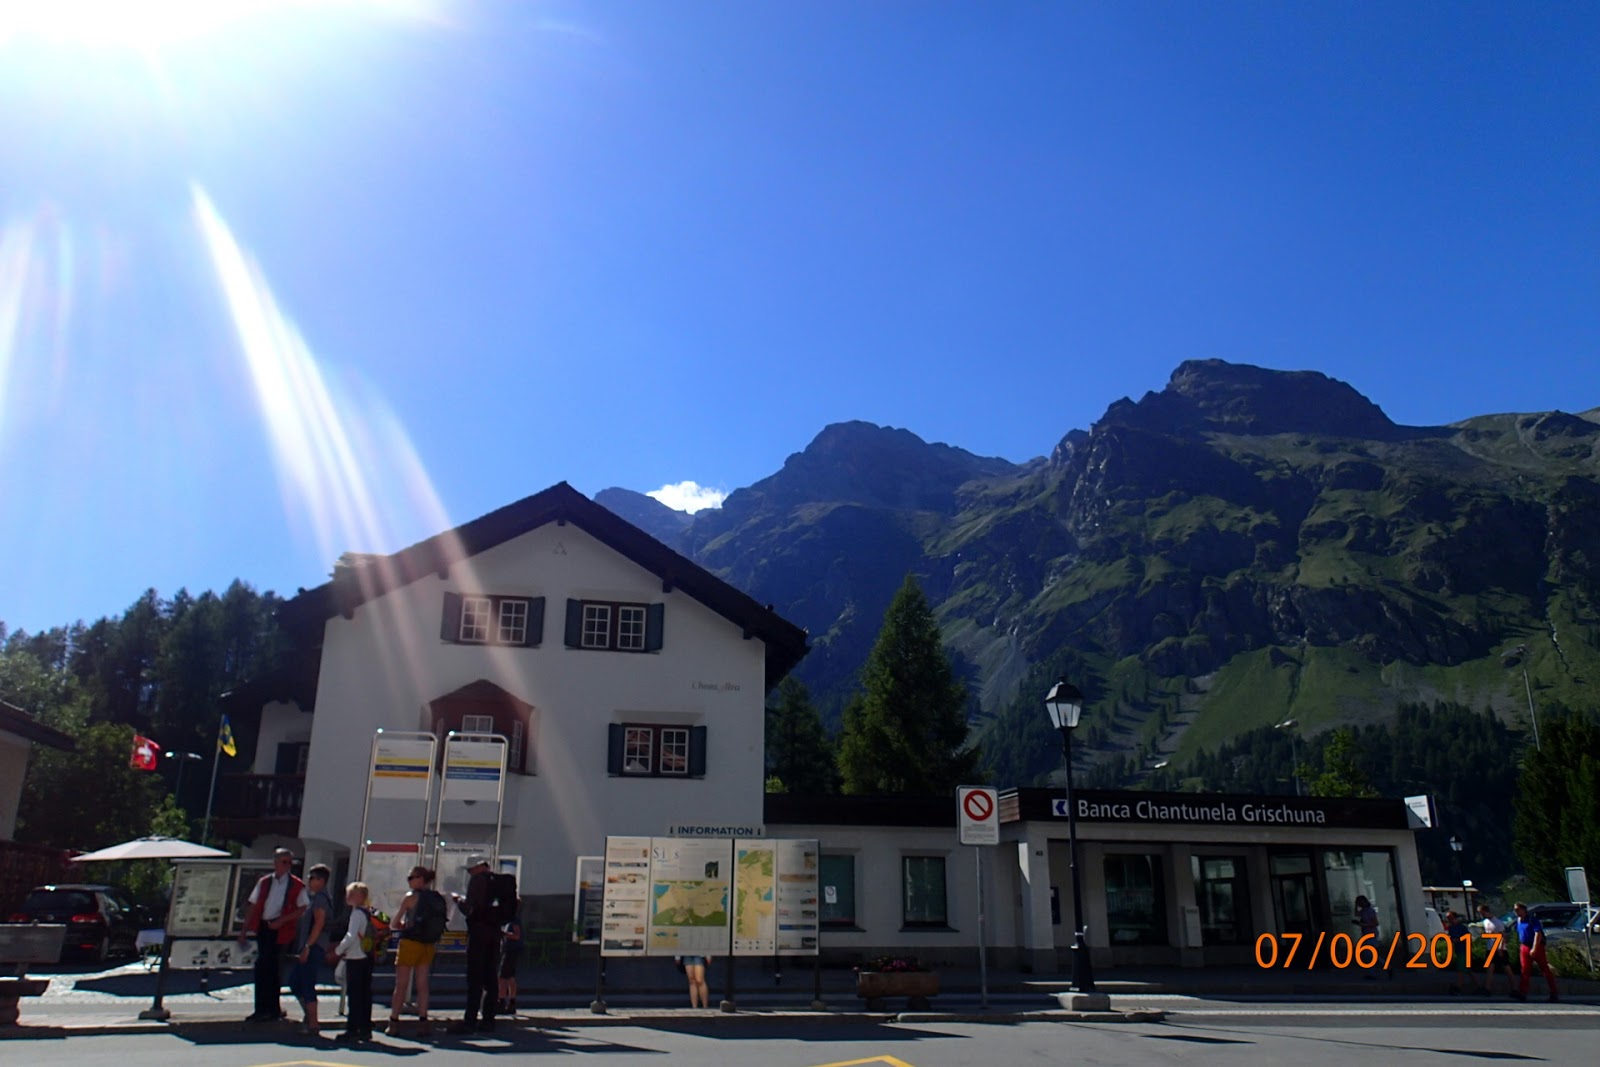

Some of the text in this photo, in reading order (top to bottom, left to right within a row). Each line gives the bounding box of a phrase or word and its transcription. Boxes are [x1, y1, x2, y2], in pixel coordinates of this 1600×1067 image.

[1077, 799, 1326, 825] Banca Chantunela Grischuna
[678, 826, 753, 835] INFORMATION
